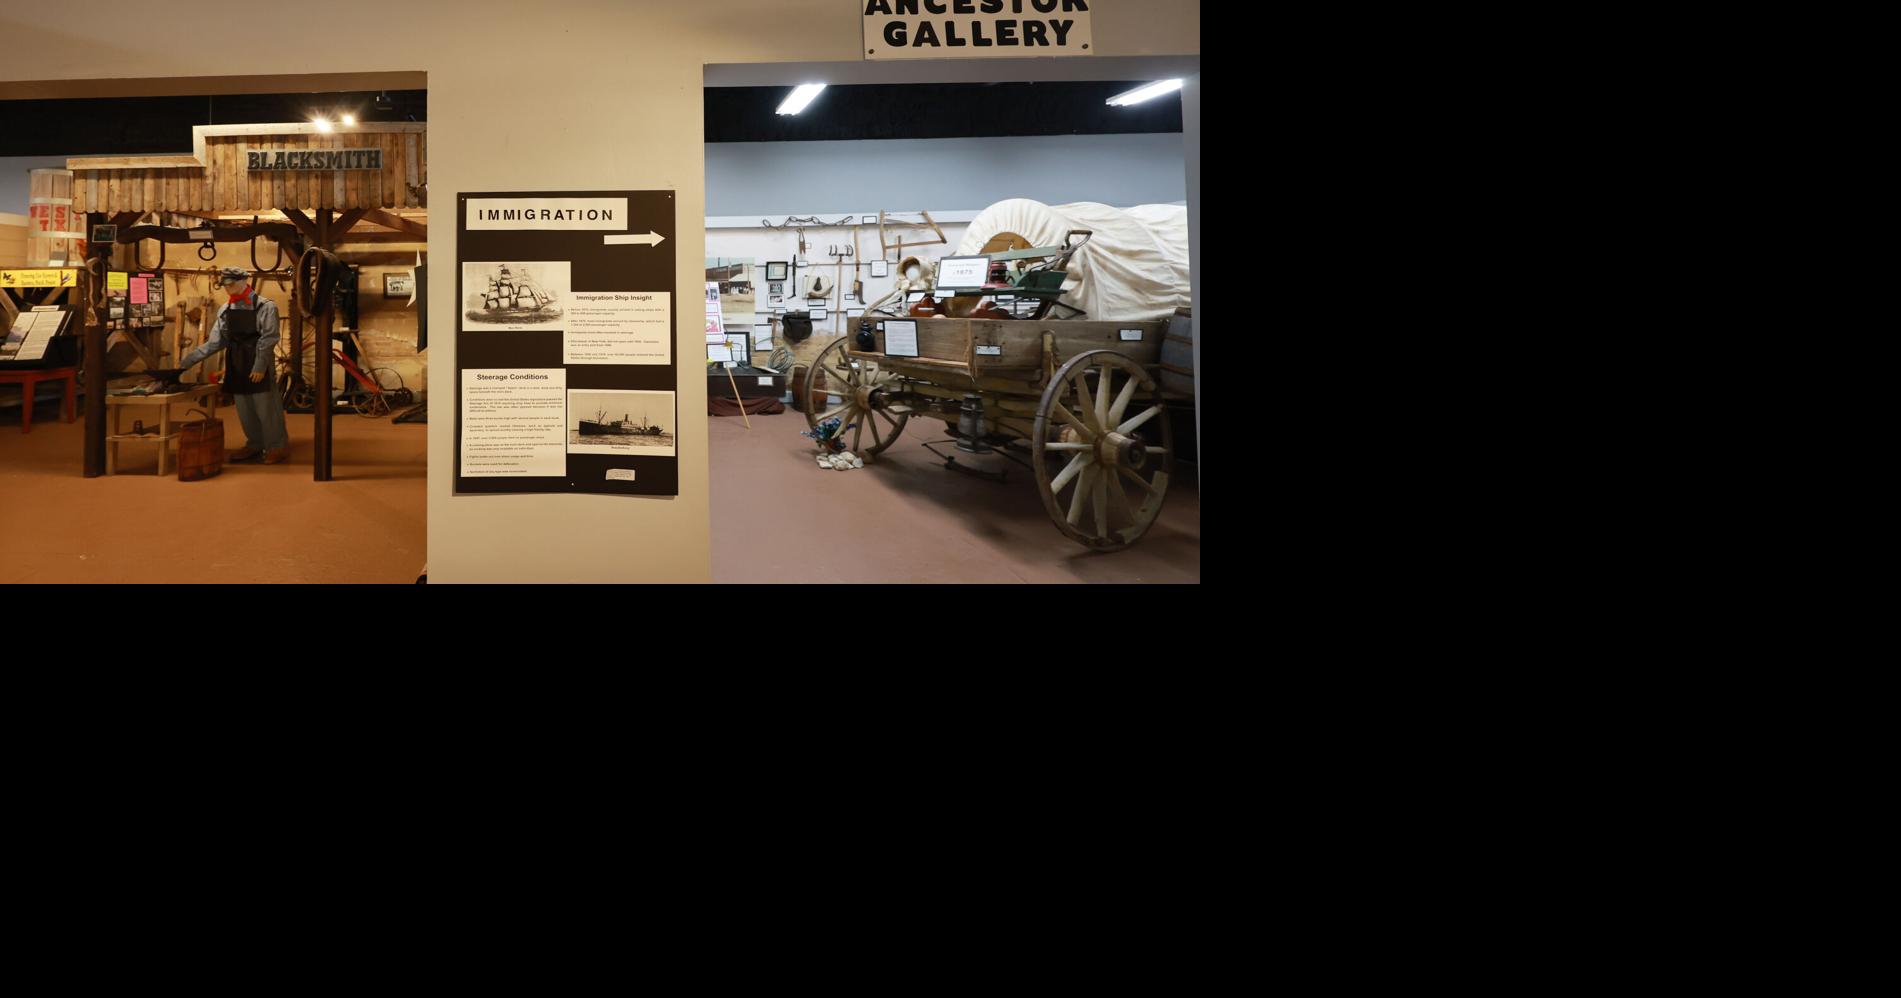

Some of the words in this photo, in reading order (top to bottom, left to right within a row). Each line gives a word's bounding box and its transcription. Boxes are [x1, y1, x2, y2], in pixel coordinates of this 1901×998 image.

[883, 20, 1074, 47] GALLERY
[247, 150, 381, 170] BLACKSMITH
[479, 209, 613, 221] IMMIGRATION
[576, 294, 614, 302] Immigration
[630, 294, 653, 302] Insight
